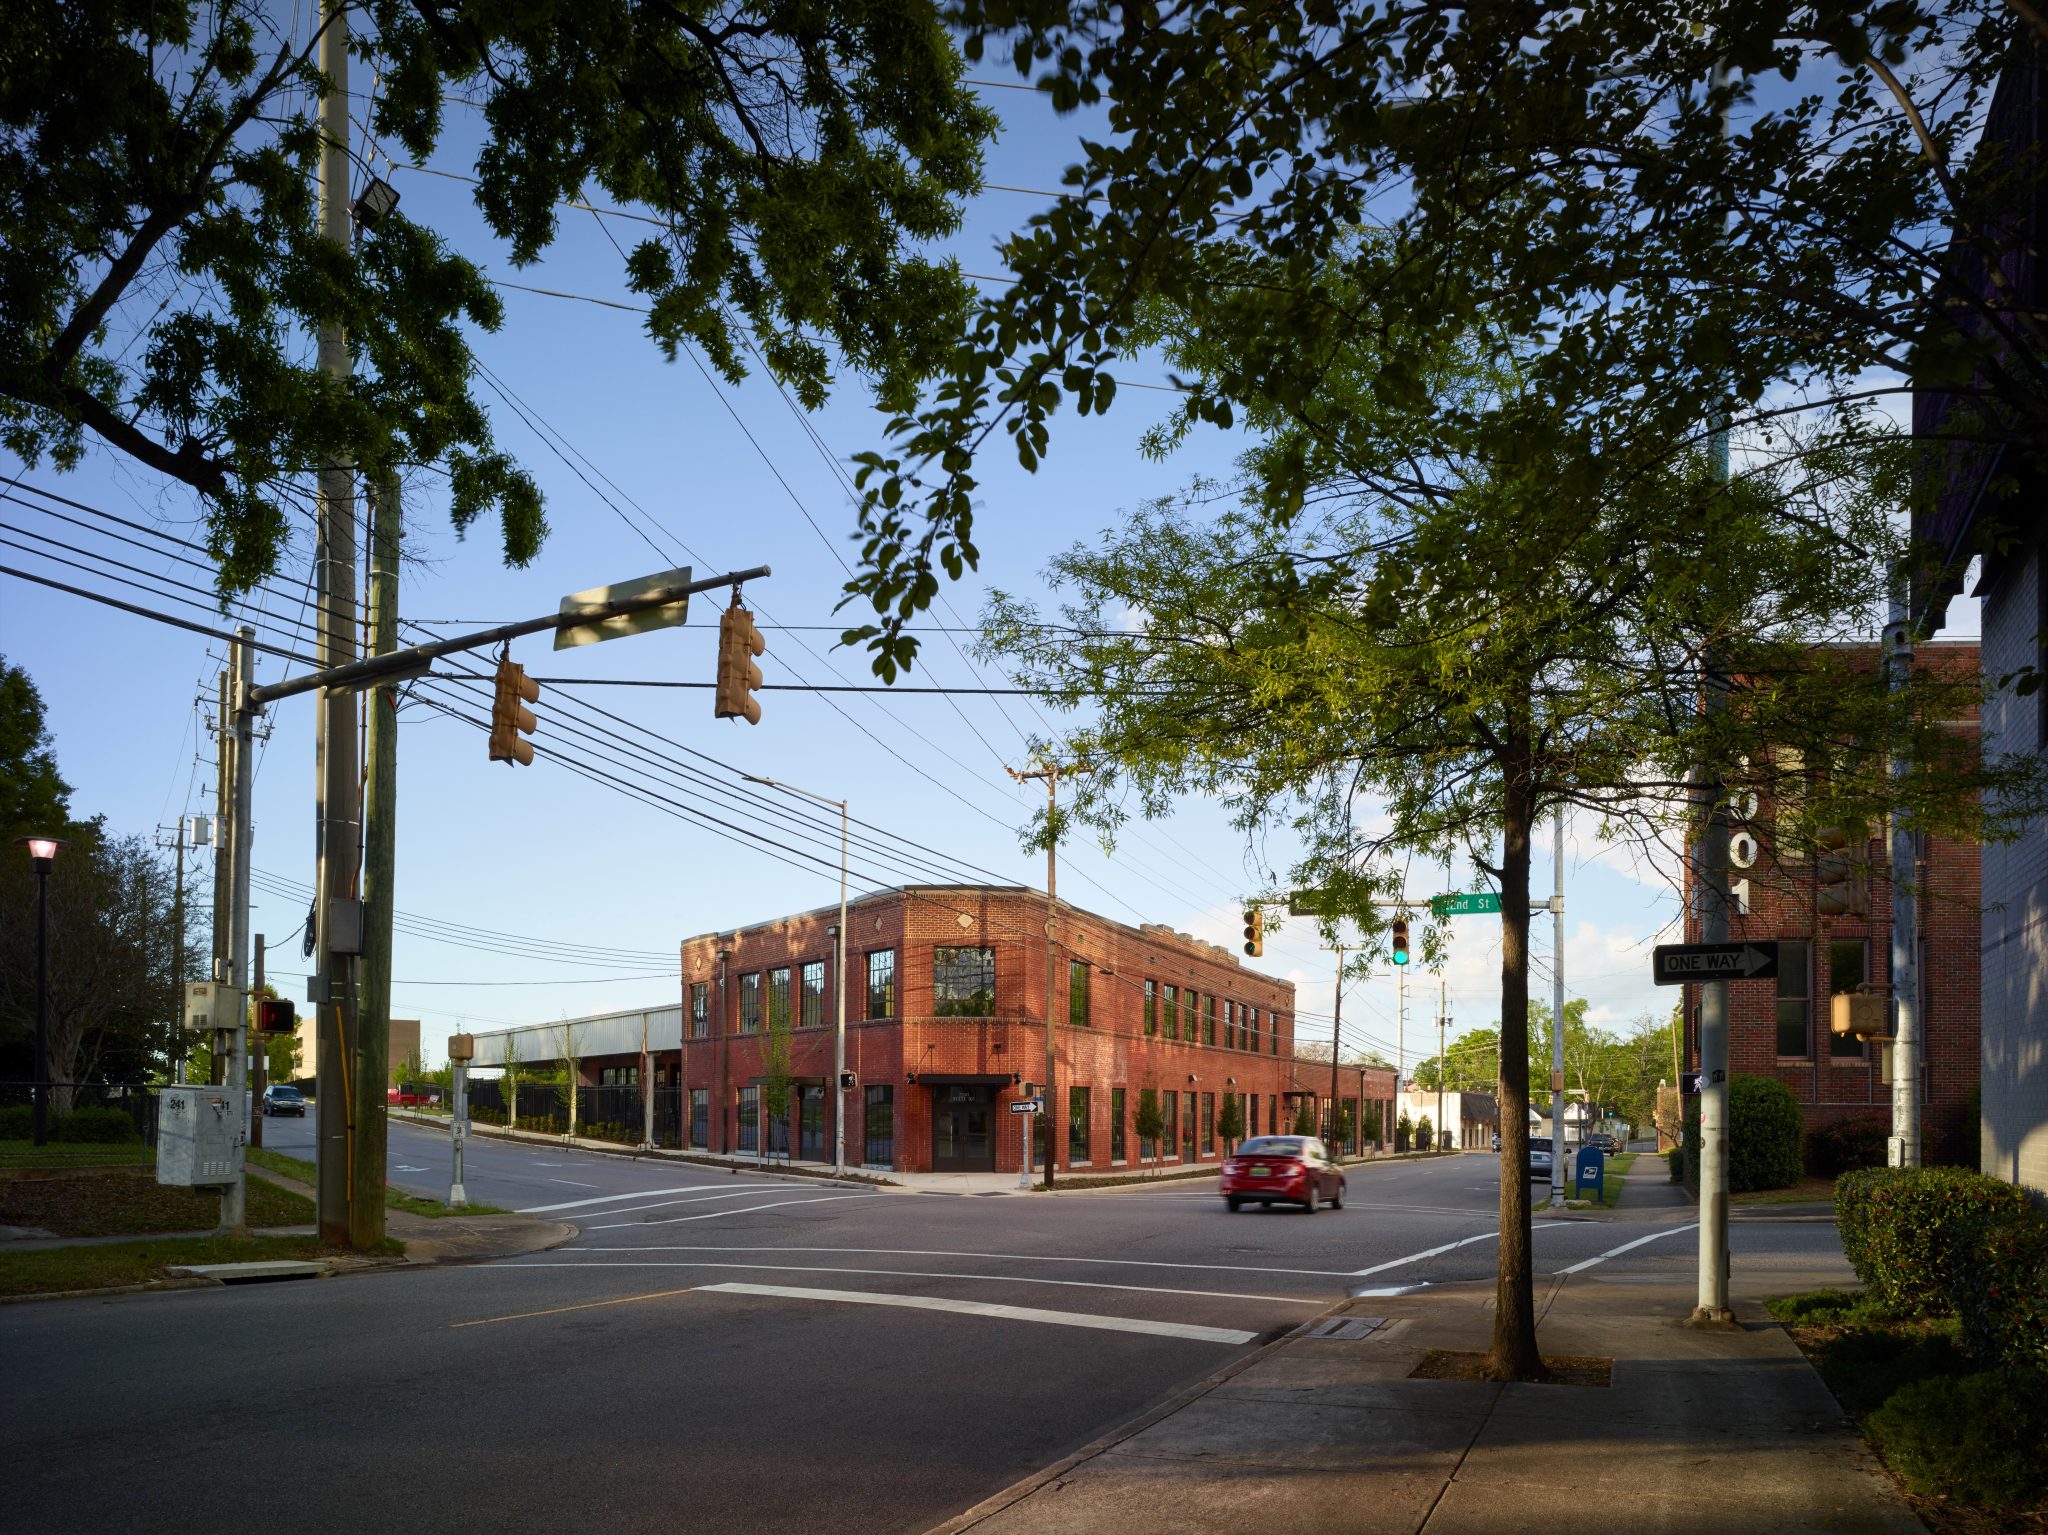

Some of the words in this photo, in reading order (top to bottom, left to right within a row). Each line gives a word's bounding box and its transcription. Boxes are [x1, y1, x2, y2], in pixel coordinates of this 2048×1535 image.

[1478, 898, 1490, 909] St
[1668, 956, 1700, 970] ONE
[1707, 954, 1739, 969] WAY
[170, 1099, 185, 1110] 241
